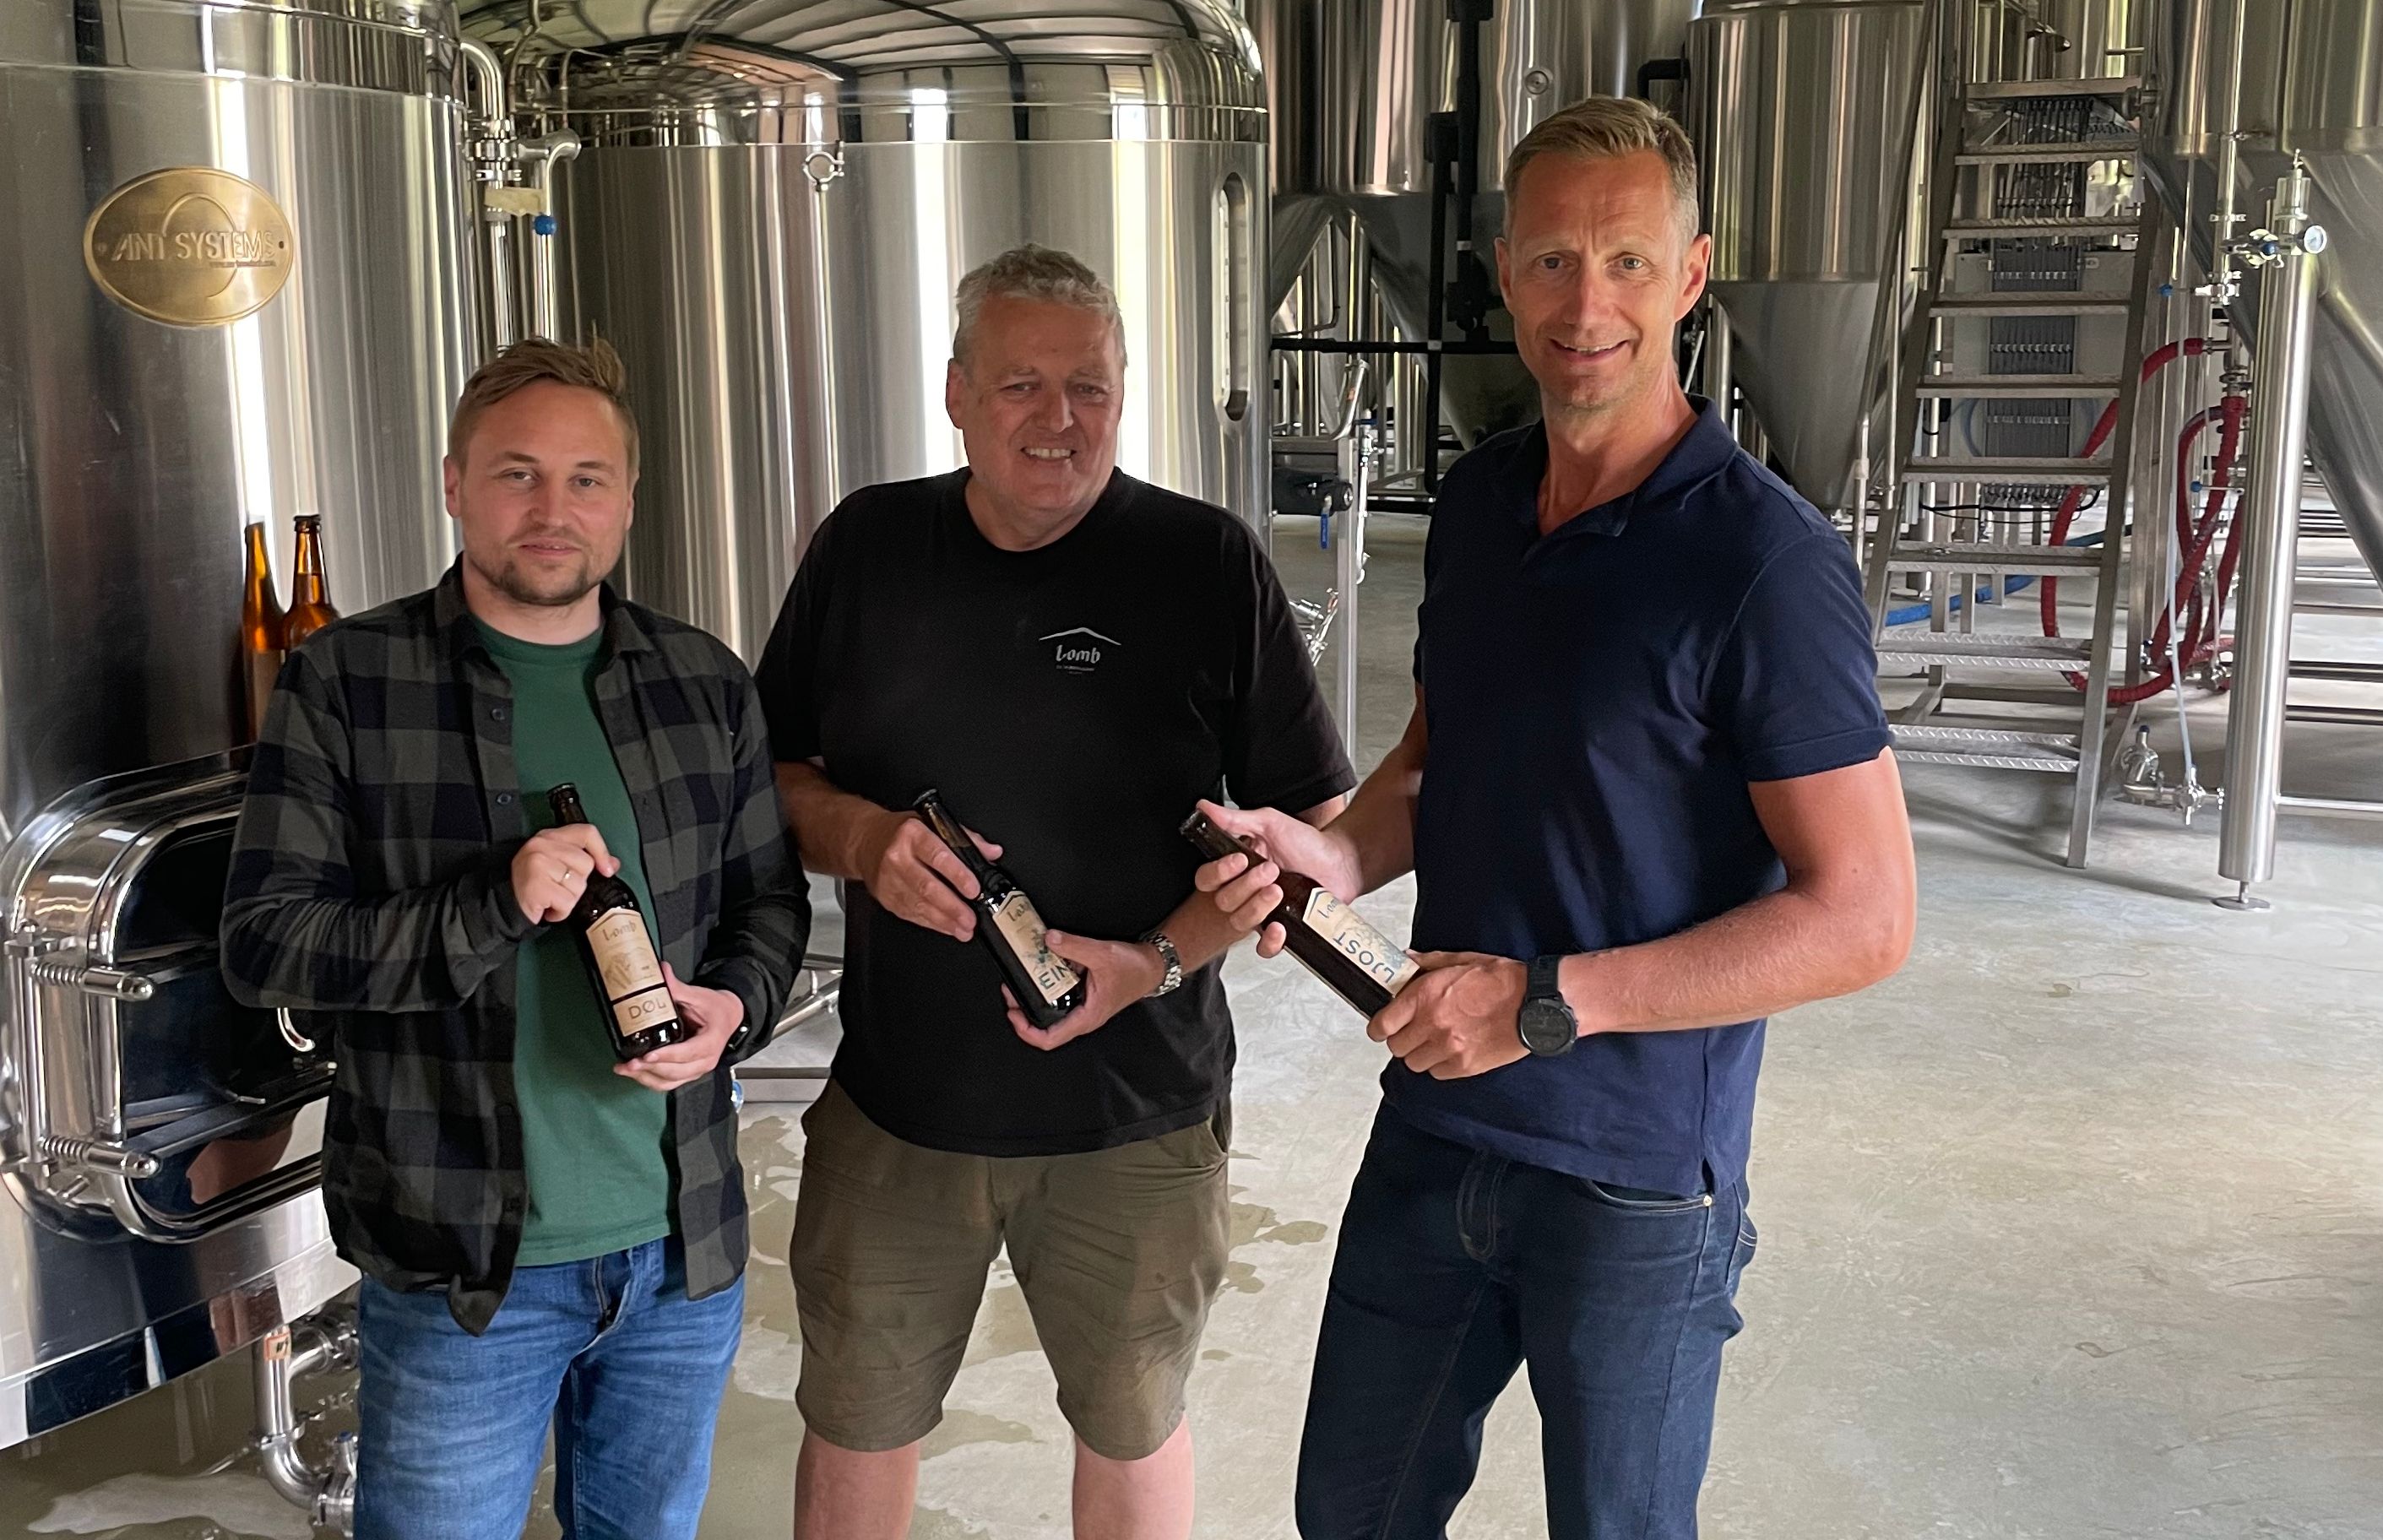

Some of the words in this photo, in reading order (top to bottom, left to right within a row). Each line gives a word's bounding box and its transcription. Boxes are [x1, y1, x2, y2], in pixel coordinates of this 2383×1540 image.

[175, 230, 274, 261] SYSTEMS
[1056, 644, 1101, 664] Lomb
[628, 998, 667, 1020] DØL
